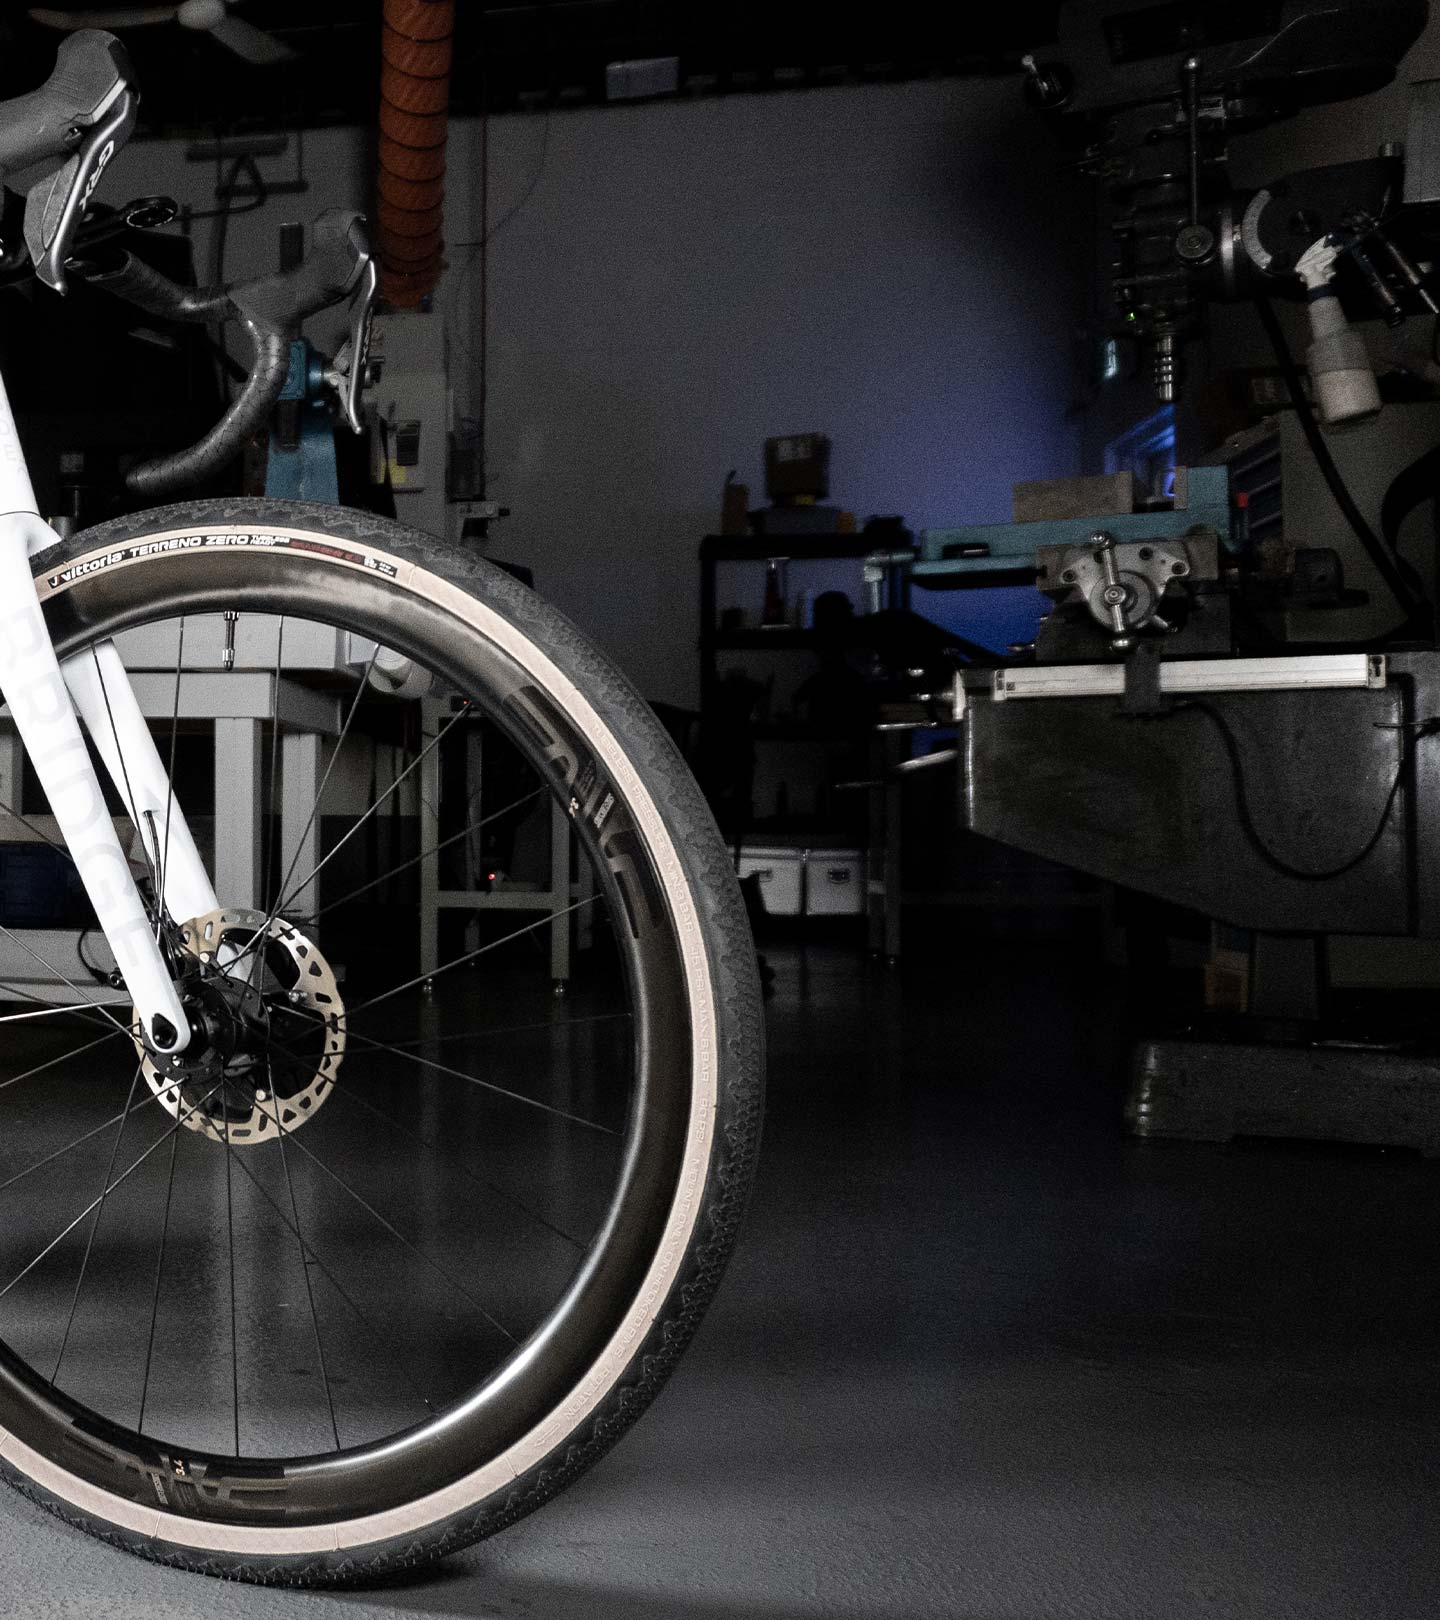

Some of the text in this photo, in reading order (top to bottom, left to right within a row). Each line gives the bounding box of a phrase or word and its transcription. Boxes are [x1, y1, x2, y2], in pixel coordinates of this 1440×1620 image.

[78, 140, 115, 213] GRX
[60, 534, 249, 583] vittoria TERRENO ZERO
